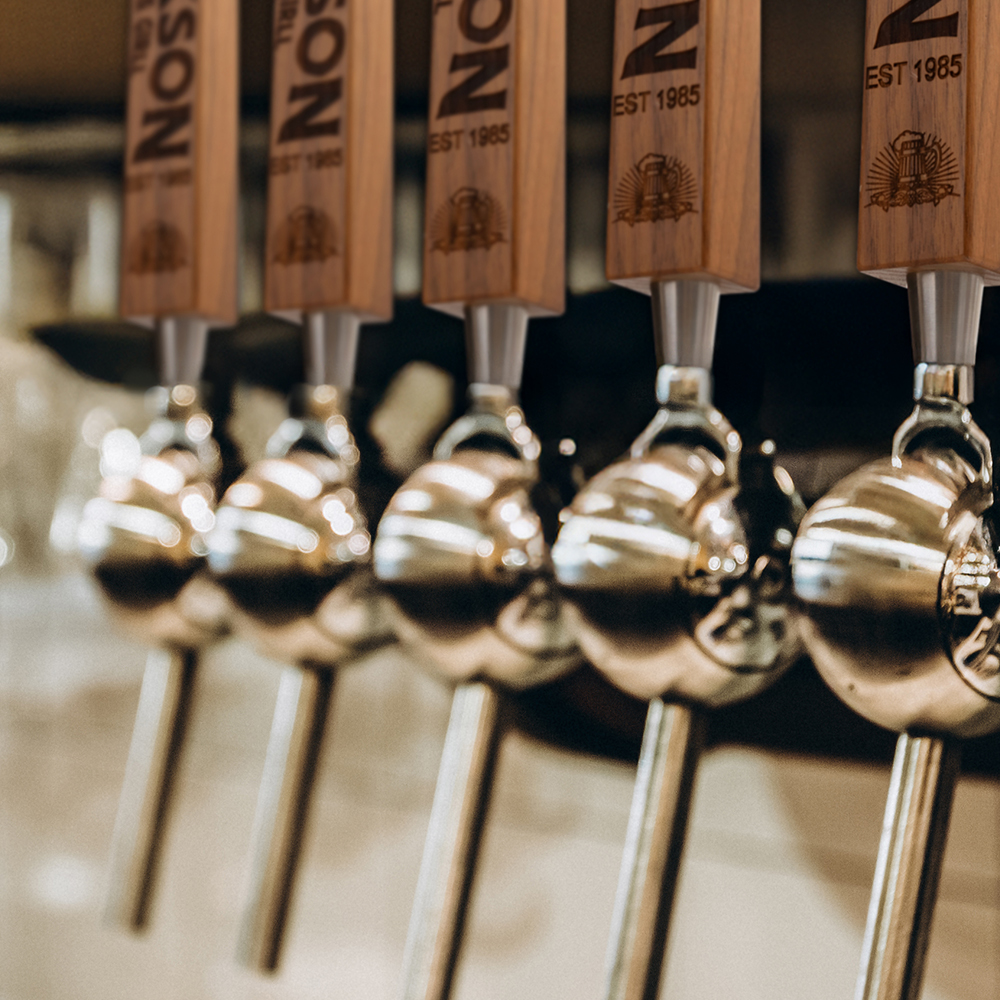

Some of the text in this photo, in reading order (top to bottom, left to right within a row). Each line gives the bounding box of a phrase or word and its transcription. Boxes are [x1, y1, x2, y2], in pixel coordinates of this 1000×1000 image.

[865, 53, 963, 90] EST 1985
[613, 83, 701, 117] EST 1985
[429, 123, 510, 153] EST 1985
